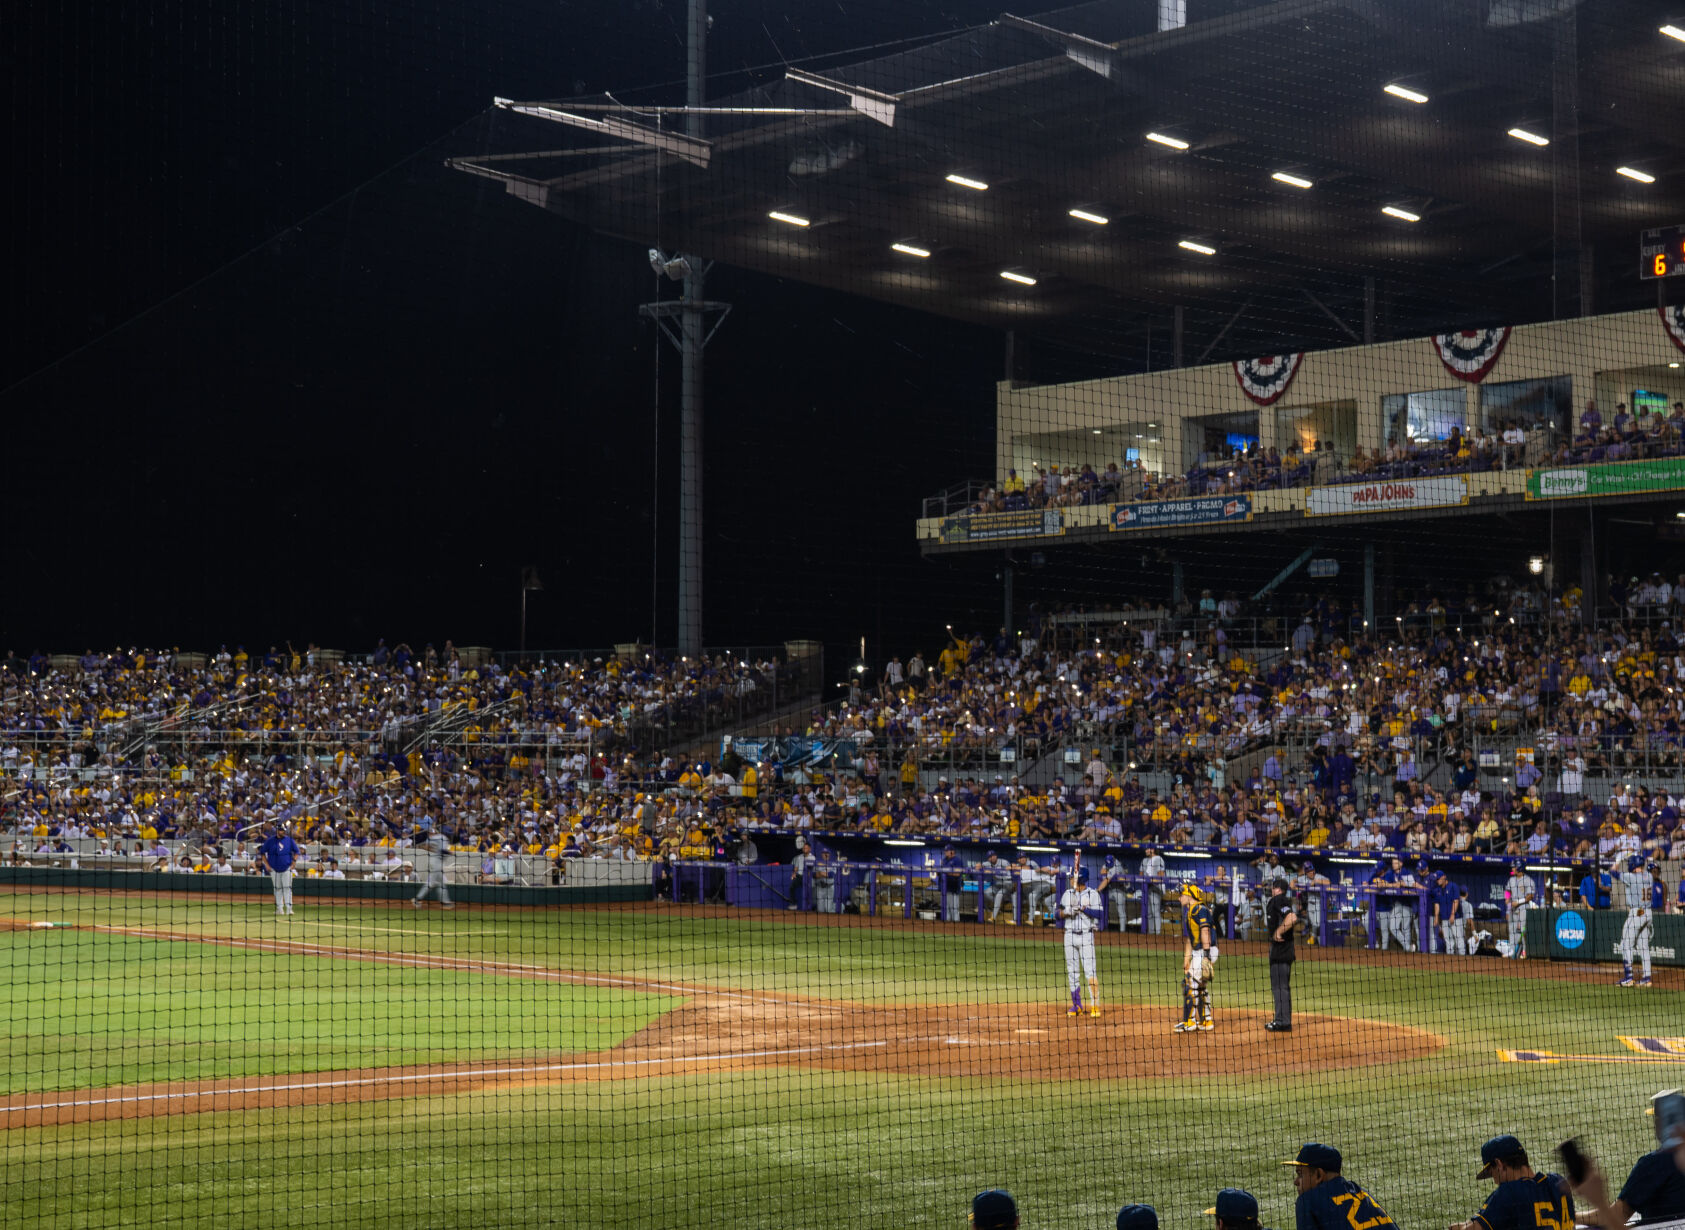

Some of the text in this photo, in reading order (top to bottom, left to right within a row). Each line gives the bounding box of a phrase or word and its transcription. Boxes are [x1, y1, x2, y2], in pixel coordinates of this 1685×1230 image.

[1654, 253, 1666, 276] 6
[1544, 476, 1583, 489] Benny's
[1353, 484, 1415, 503] PAPA JOHNS
[1138, 505, 1157, 515] PRINT
[1162, 502, 1193, 513] APPAREL
[1196, 500, 1223, 510] PROMO
